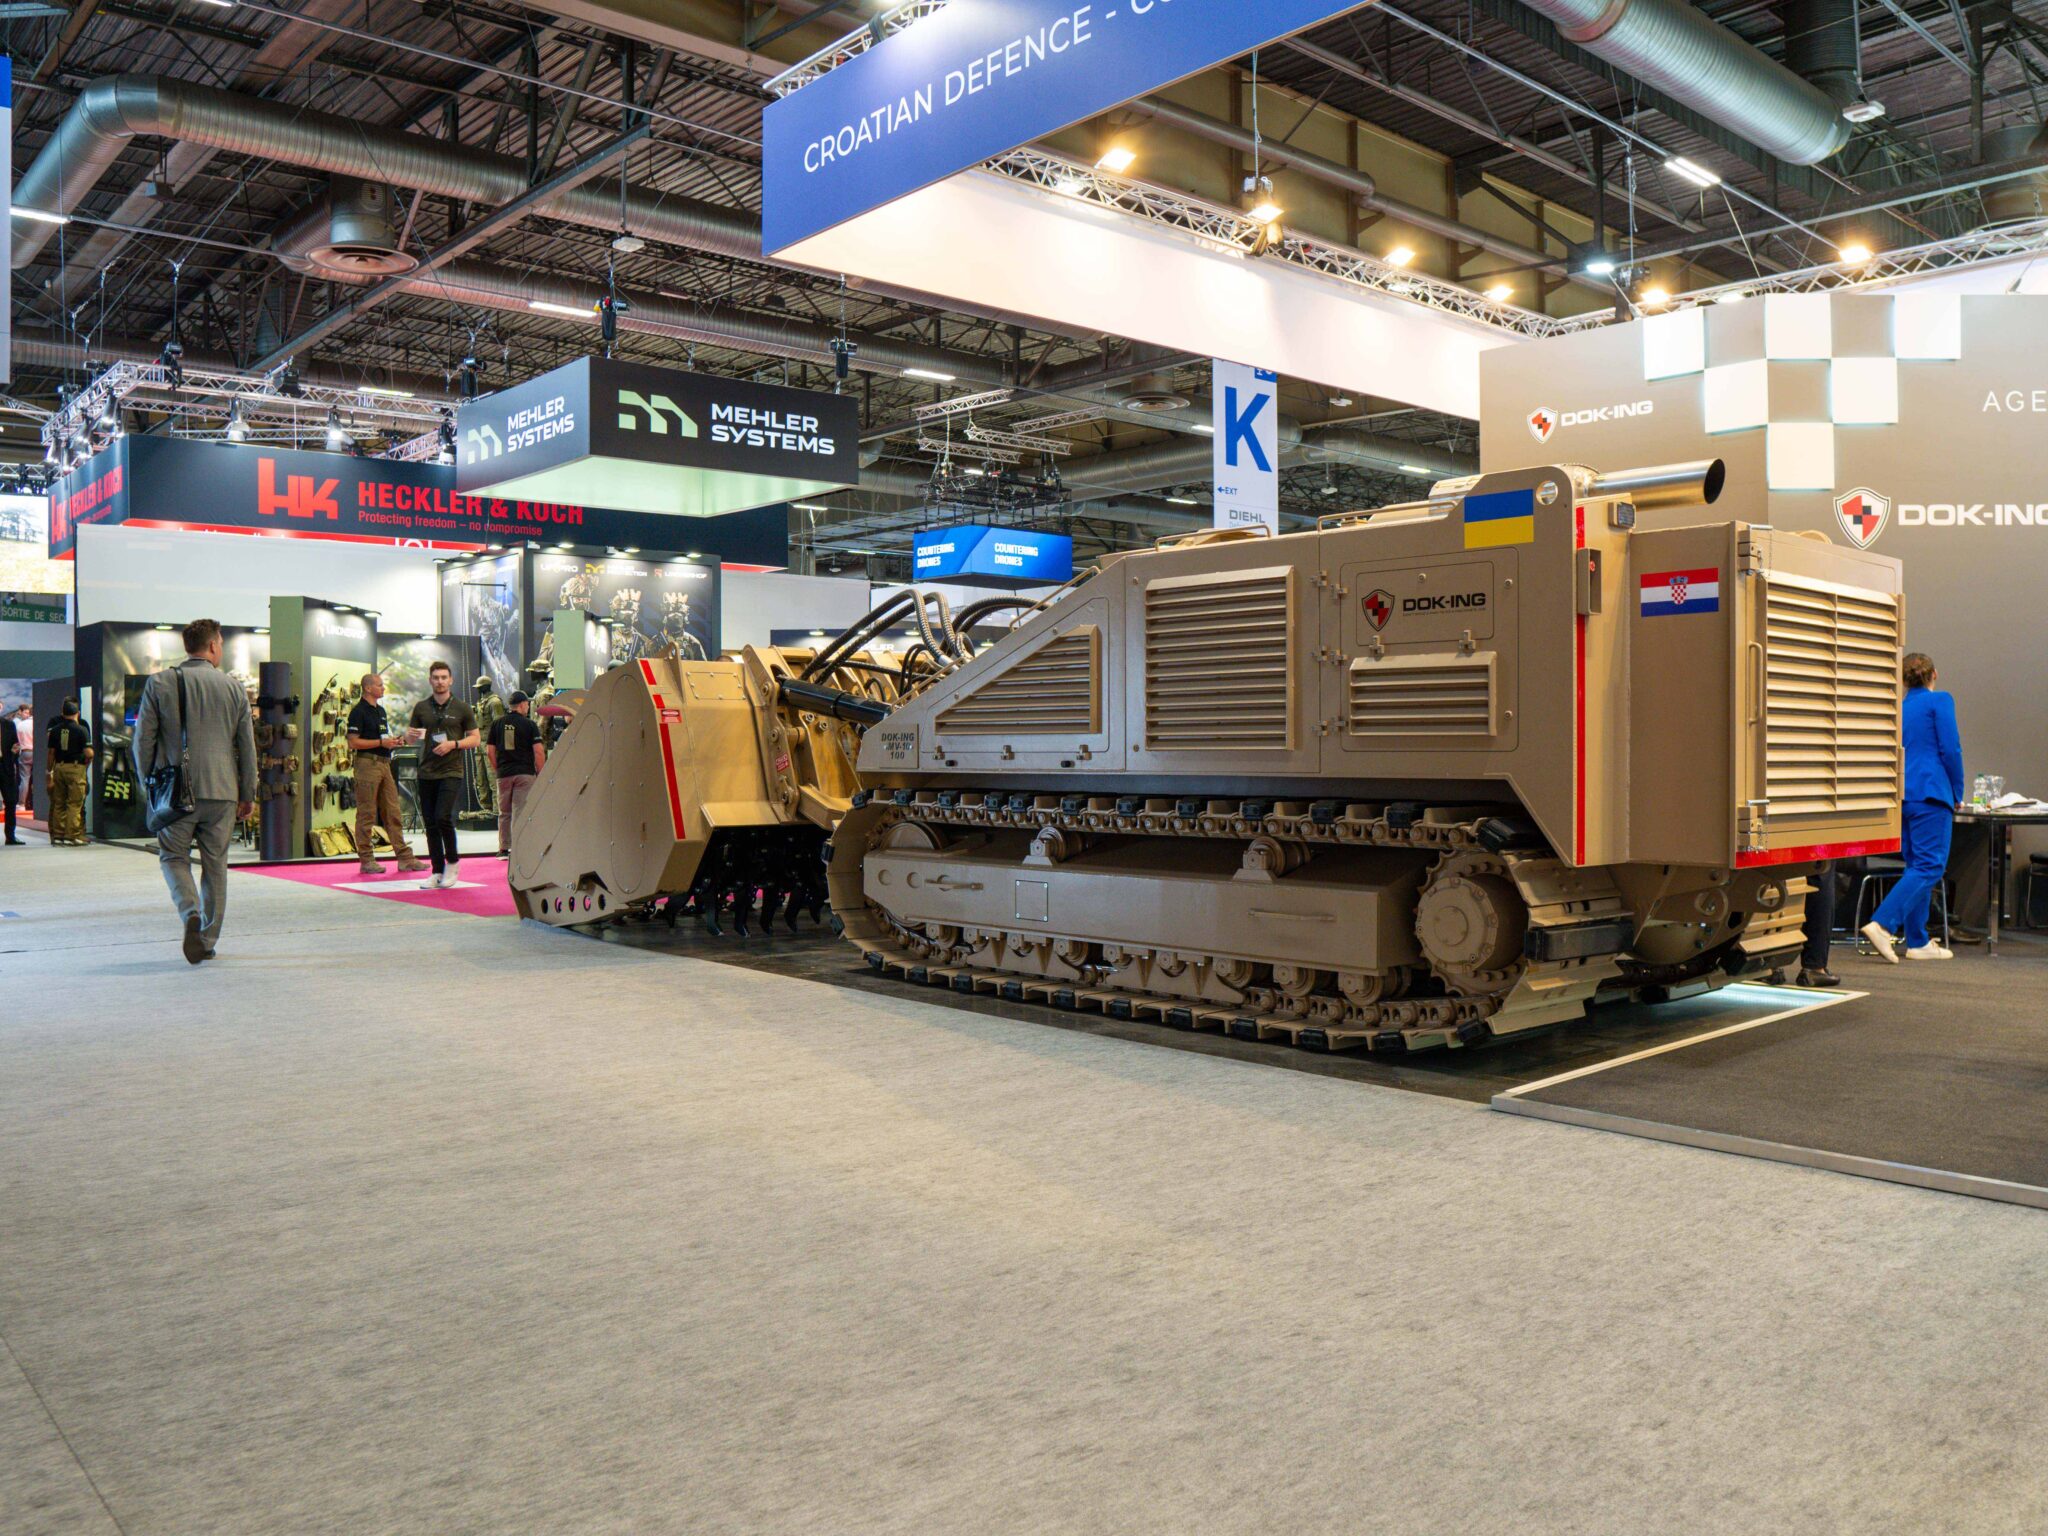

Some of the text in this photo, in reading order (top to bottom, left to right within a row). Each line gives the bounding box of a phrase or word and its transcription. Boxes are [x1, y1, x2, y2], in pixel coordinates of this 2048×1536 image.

[803, 83, 933, 173] CROATIAN
[945, 4, 1092, 106] DEFENCE
[507, 396, 565, 432] MEHLER
[711, 403, 819, 434] MEHLER
[1560, 400, 1654, 427] DOK-ING
[507, 413, 575, 453] SYSTEMS
[711, 424, 836, 456] SYSTEMS
[1225, 386, 1272, 472] K
[257, 457, 341, 520] HK
[1225, 486, 1238, 496] EXT
[358, 481, 584, 525] HECKLER & KOCH
[358, 510, 412, 528] Protecting
[415, 515, 457, 529] freedom
[469, 520, 482, 531] no
[484, 522, 543, 536] compromise
[1229, 509, 1266, 524] DIEHL
[917, 543, 955, 556] COUNTERING
[994, 543, 1039, 557] COUNTERING
[994, 555, 1023, 566] DRONES
[917, 556, 942, 568] DRONES
[2, 606, 31, 619] SORTIE
[34, 610, 46, 620] DE
[1402, 592, 1487, 612] DOK-ING
[881, 732, 915, 742] DOK-ING
[891, 751, 905, 760] 100
